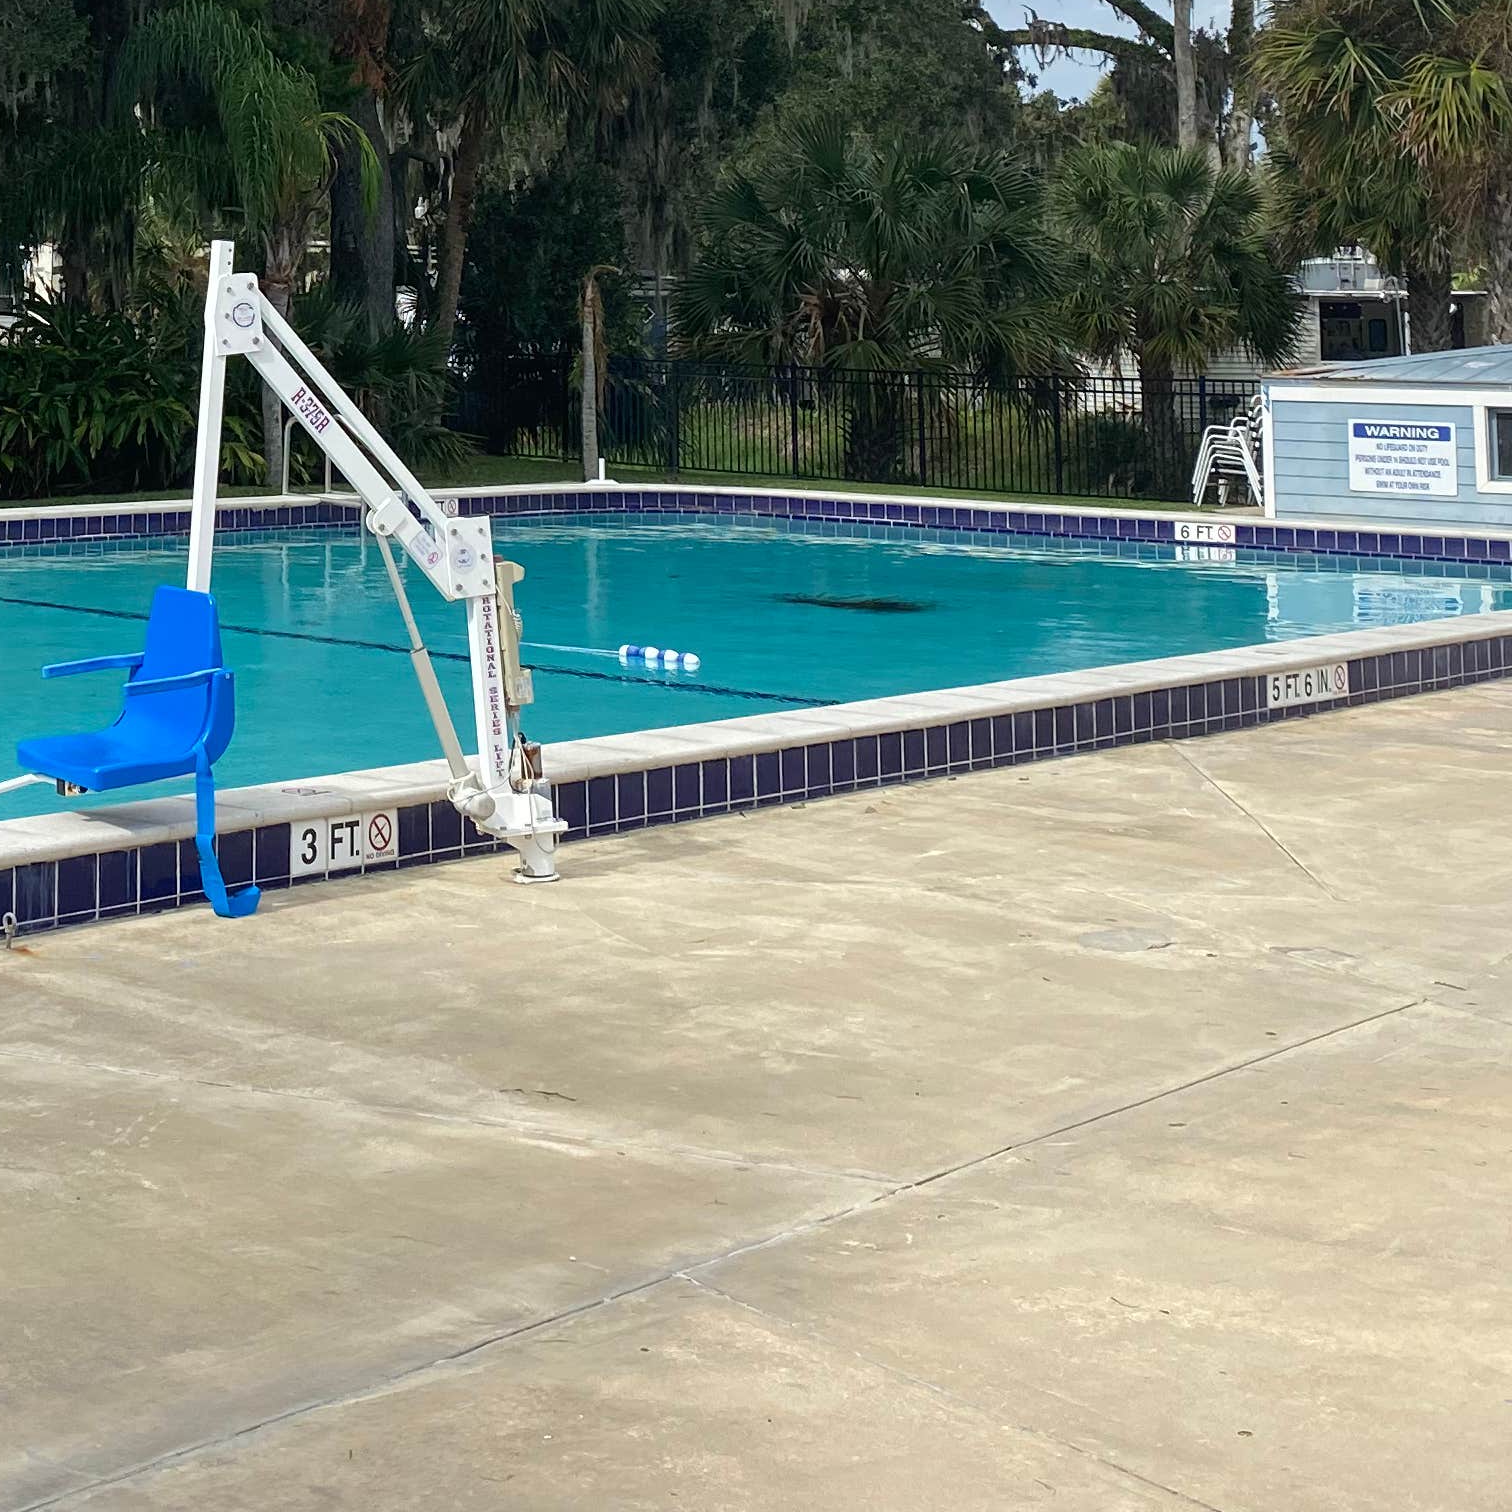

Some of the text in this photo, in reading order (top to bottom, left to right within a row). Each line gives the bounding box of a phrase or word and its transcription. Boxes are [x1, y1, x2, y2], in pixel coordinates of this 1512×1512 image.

[1364, 425, 1440, 439] WARNING
[1181, 525, 1190, 539] 6
[482, 596, 505, 777] ROTATIONAL SERIES LIFT
[1272, 676, 1280, 701] 5
[1304, 673, 1313, 697] 6
[301, 820, 360, 865] 3 FT.
